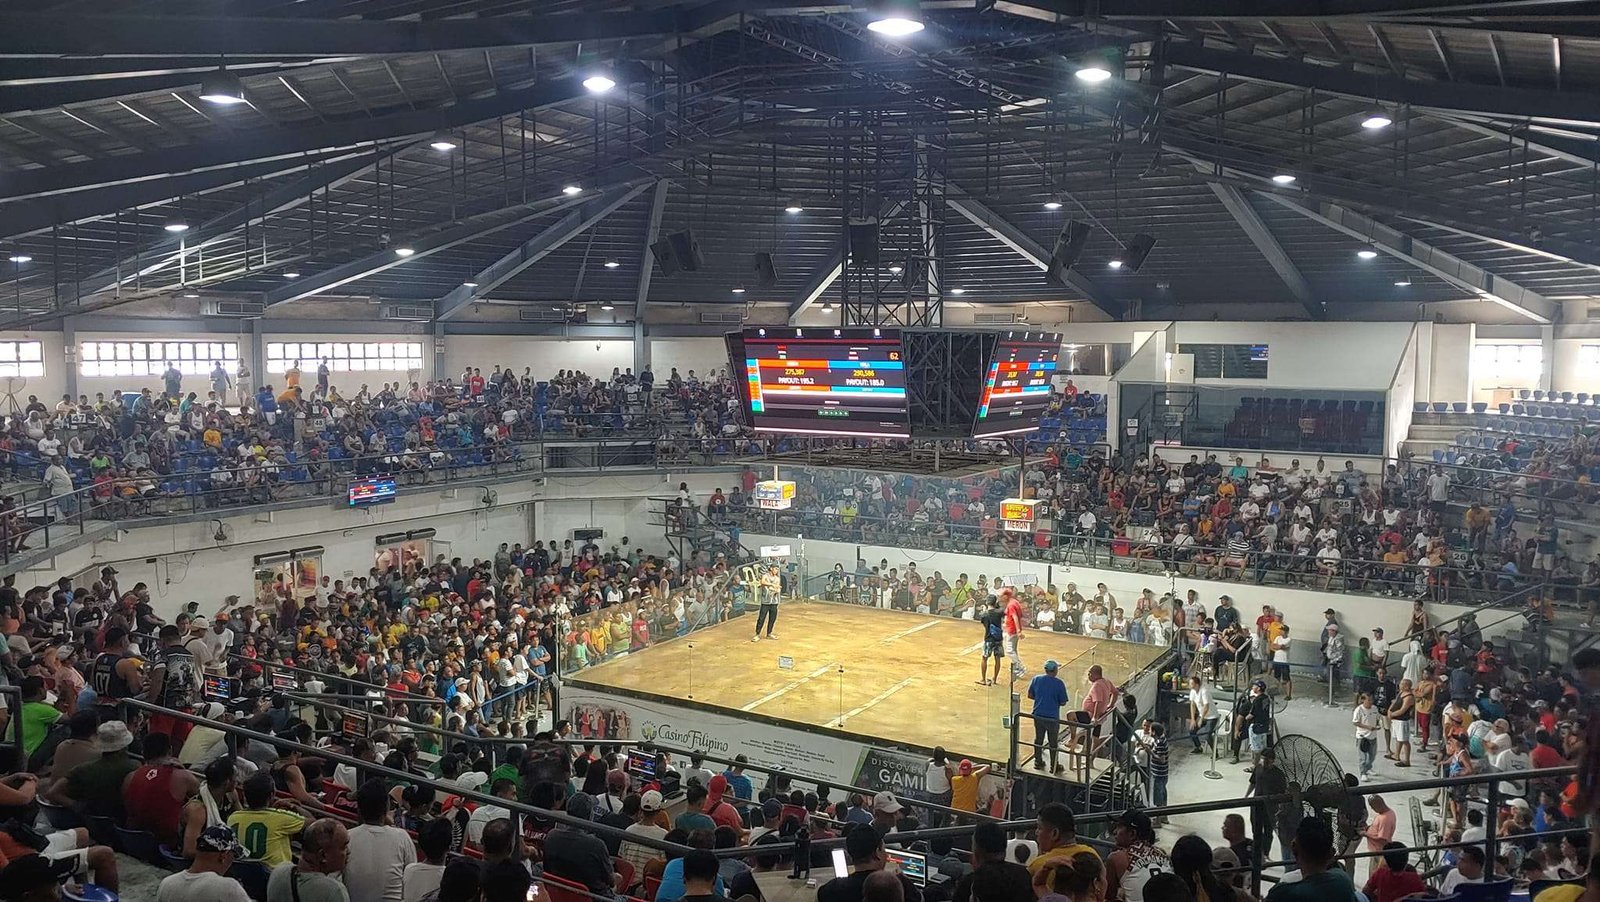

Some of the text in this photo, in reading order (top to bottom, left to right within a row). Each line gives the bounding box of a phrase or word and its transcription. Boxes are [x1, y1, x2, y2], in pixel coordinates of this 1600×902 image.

[1007, 520, 1028, 529] MERON
[95, 671, 110, 697] 07
[658, 724, 688, 743] Casino
[688, 730, 729, 753] Filipino
